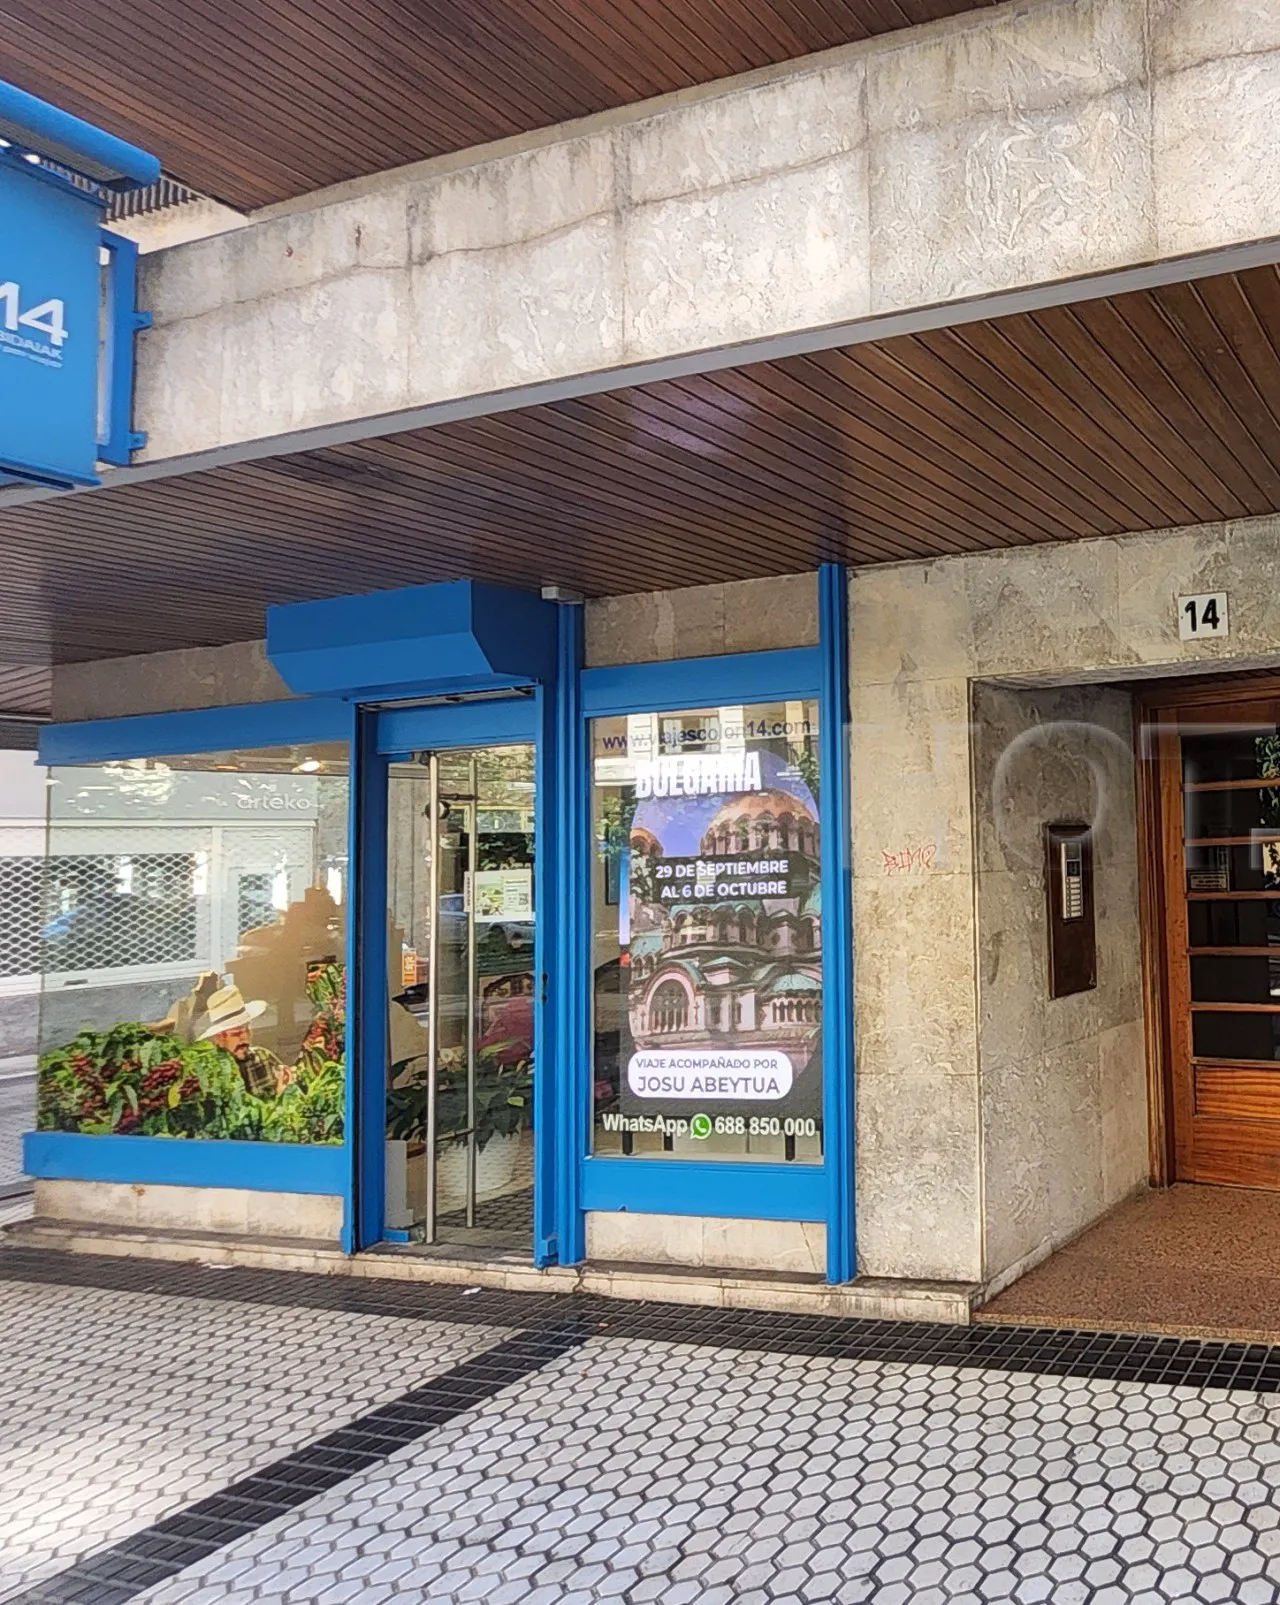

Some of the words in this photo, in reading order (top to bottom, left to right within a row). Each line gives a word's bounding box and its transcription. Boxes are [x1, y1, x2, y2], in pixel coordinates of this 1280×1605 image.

[1184, 598, 1220, 632] 14
[603, 719, 811, 750] www.viajescolon14.com
[655, 864, 672, 878] 29
[675, 863, 695, 877] DE
[696, 860, 789, 876] SEPTIEMBRE
[660, 885, 679, 898] AL
[682, 885, 692, 898] 6
[694, 884, 715, 897] DE
[717, 881, 787, 896] OCTUBRE
[635, 1058, 666, 1069] VIAJE
[668, 1056, 751, 1069] ACOMPAÑADO
[753, 1059, 778, 1070] POR
[637, 1077, 685, 1092] JOSU
[690, 1077, 780, 1094] ABEYTUA
[602, 1113, 688, 1135] WhatsApp
[714, 1117, 745, 1135] 688
[749, 1117, 780, 1136] 850
[784, 1118, 815, 1137] 000
